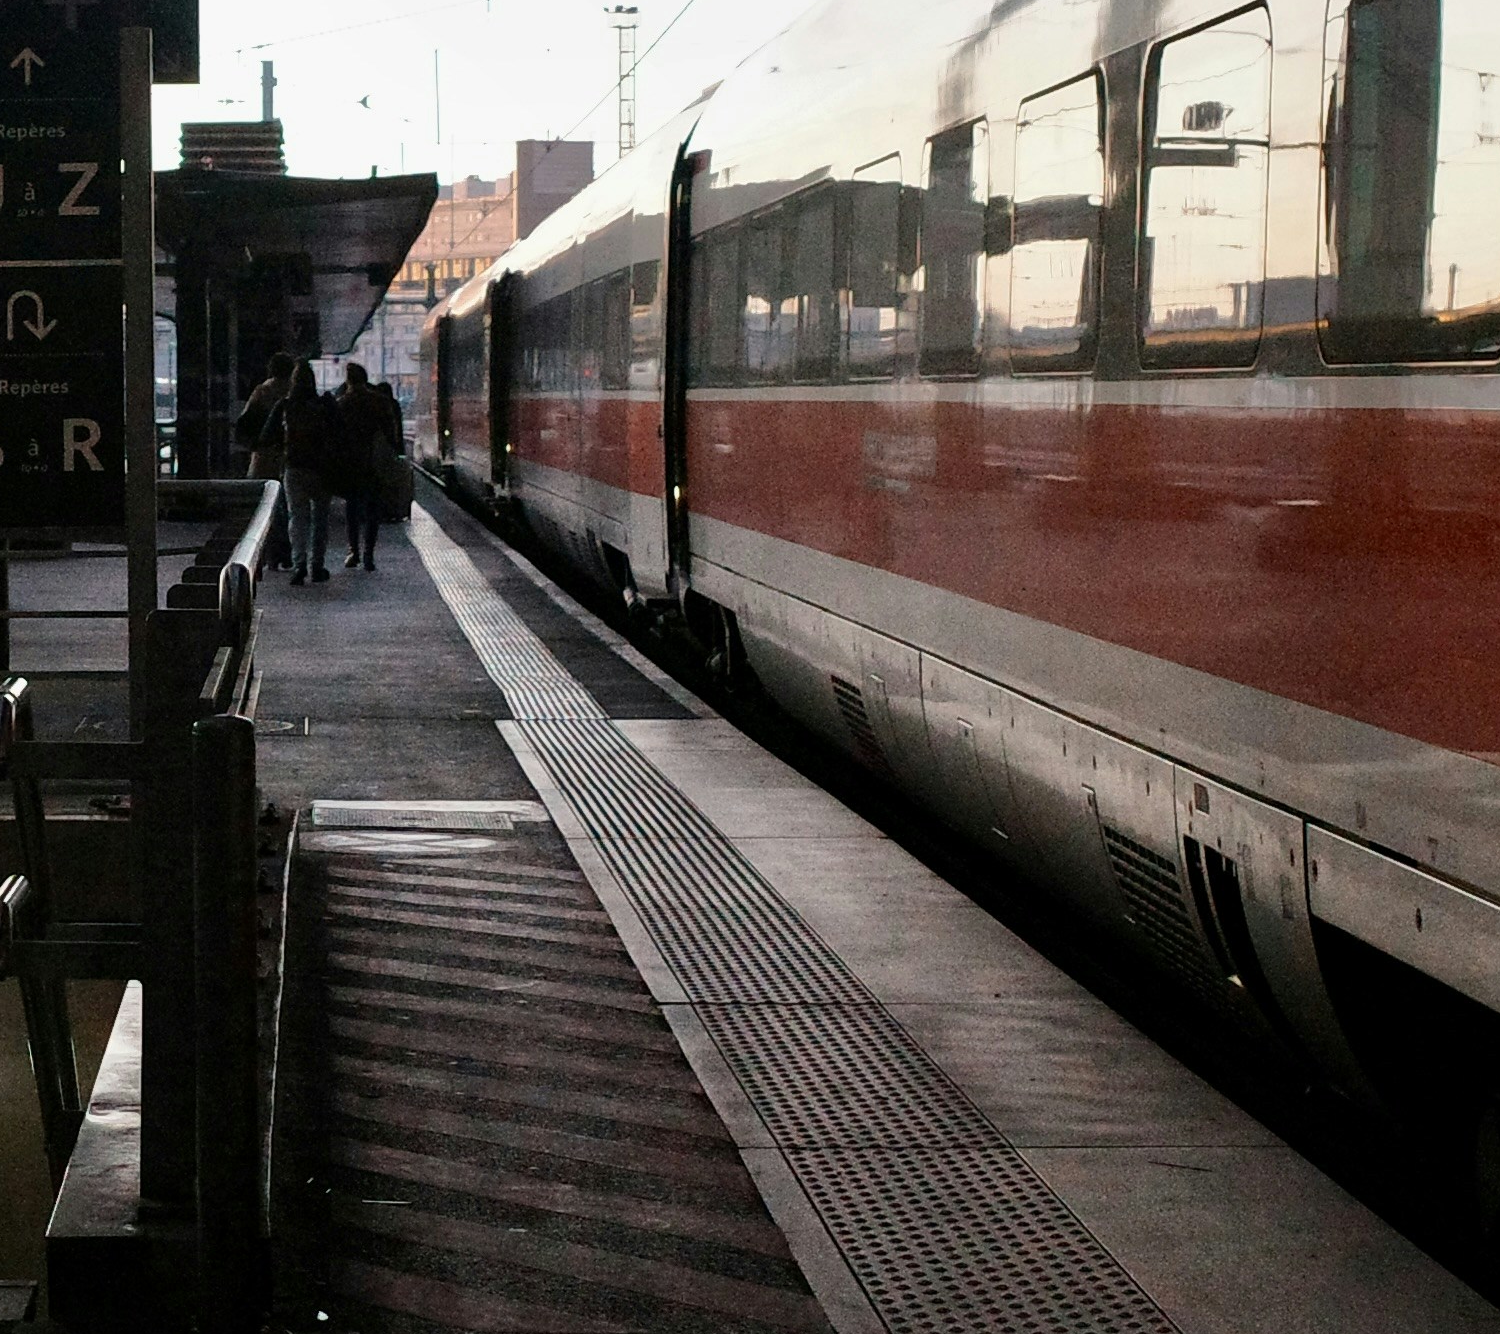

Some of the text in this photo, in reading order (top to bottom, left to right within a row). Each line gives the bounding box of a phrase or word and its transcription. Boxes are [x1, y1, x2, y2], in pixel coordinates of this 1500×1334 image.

[23, 181, 37, 203] à
[57, 162, 102, 217] Z
[27, 438, 40, 457] à
[62, 418, 106, 473] R
